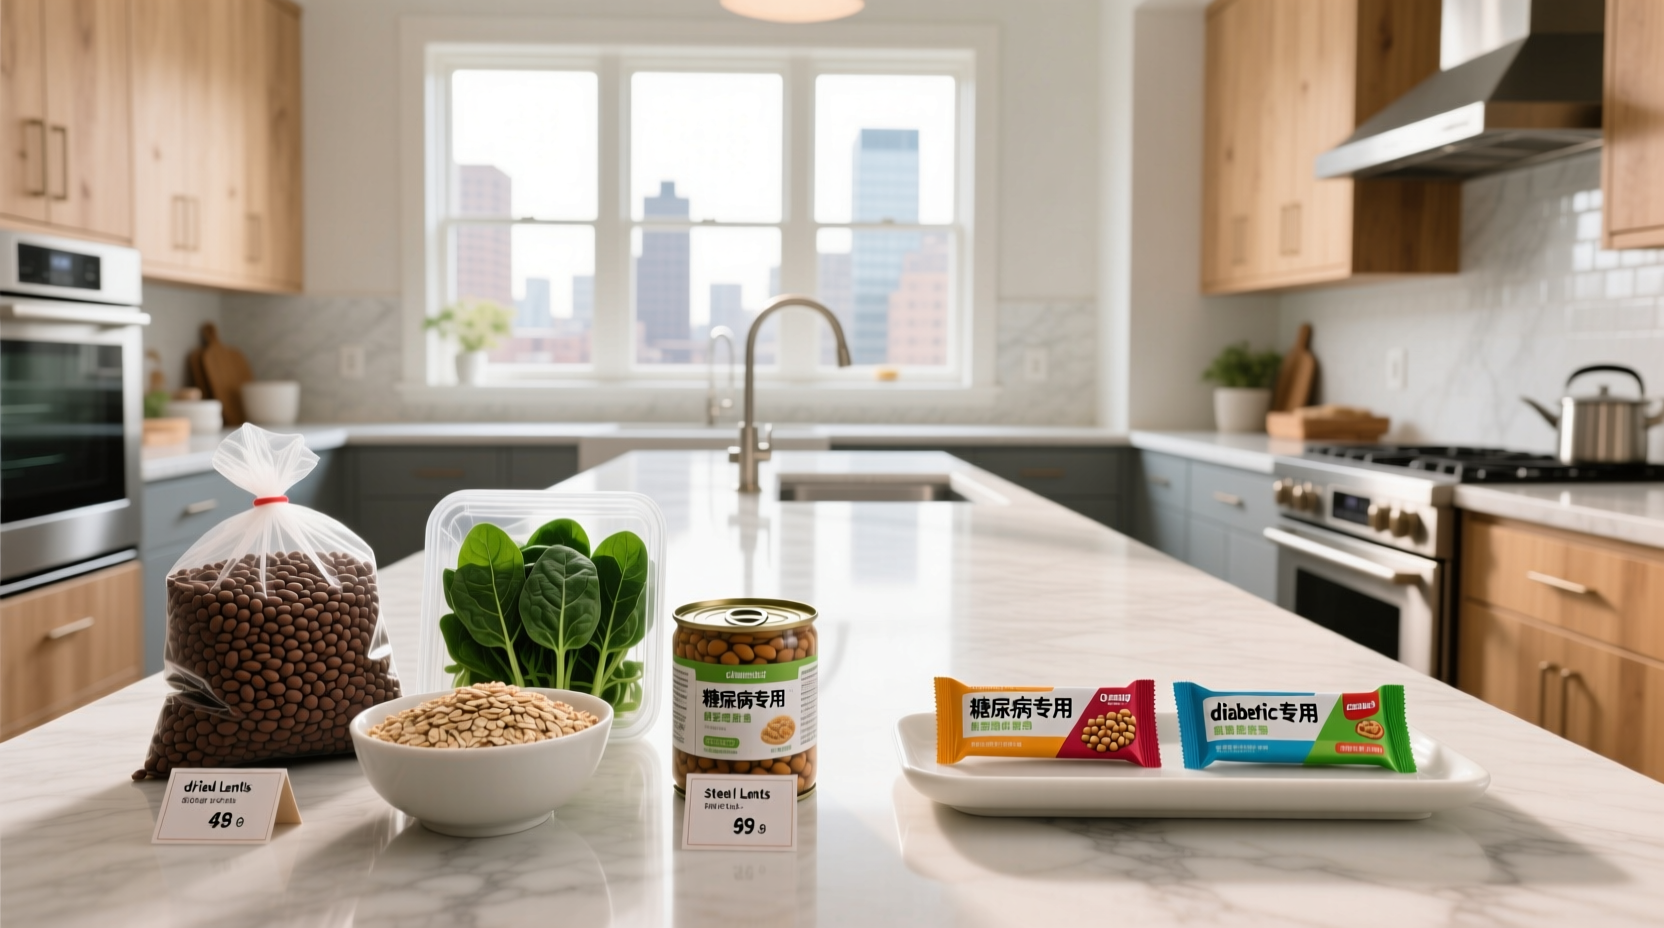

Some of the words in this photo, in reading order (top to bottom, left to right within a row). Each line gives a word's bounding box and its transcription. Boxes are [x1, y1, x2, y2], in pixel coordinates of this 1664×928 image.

[702, 688, 785, 709] 糖尿病专用
[970, 696, 1073, 719] 糖尿病专用
[1210, 701, 1318, 723] diabetic专用
